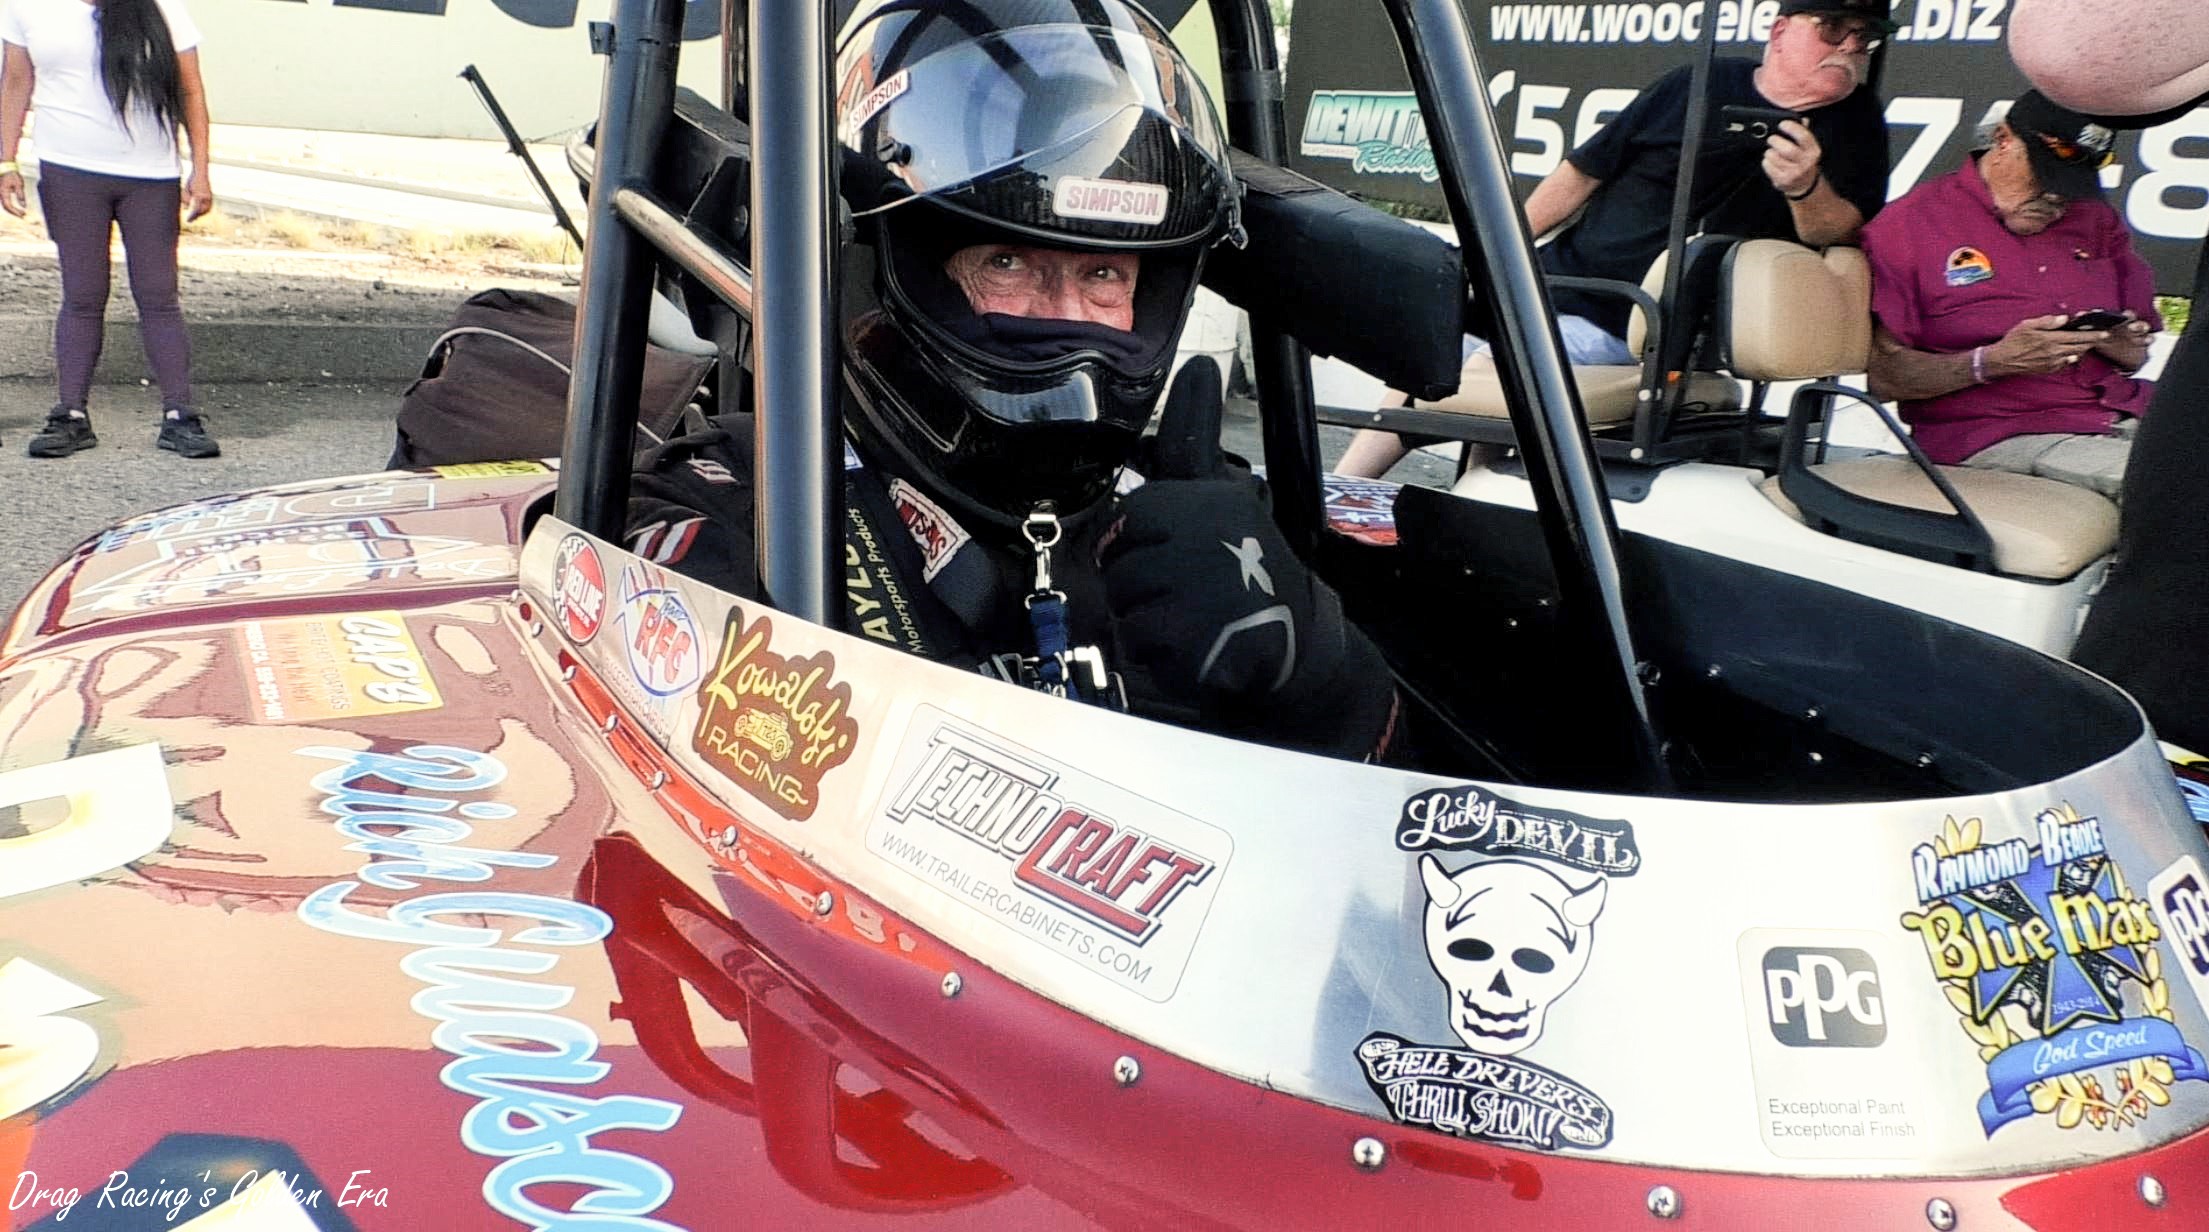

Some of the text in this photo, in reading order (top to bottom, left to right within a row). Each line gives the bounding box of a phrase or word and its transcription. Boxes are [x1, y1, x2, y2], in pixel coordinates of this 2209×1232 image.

[852, 77, 902, 127] SIMPSON
[1066, 186, 1159, 216] SIMPSON
[848, 507, 886, 564] Products
[634, 605, 691, 684] RFC
[873, 562, 930, 655] Motorsports
[706, 726, 809, 805] RACING
[291, 744, 559, 890] Rich
[1400, 790, 1636, 868] Lucky DEVIL
[1913, 811, 2104, 904] RAYMOND BEADLE
[882, 831, 1153, 984] WWW.TRAILERCABINETS.COM
[1901, 901, 2056, 981] Blue
[1766, 954, 1884, 1040] PPG
[297, 880, 690, 1232] Guasc
[1377, 1053, 1602, 1124] HELL DRIVERS
[2033, 1025, 2148, 1075] God Speed
[1386, 1080, 1471, 1132] THRILL
[1769, 1098, 1906, 1117] Exceptional Paint
[1772, 1121, 1916, 1139] Exceptional Finish
